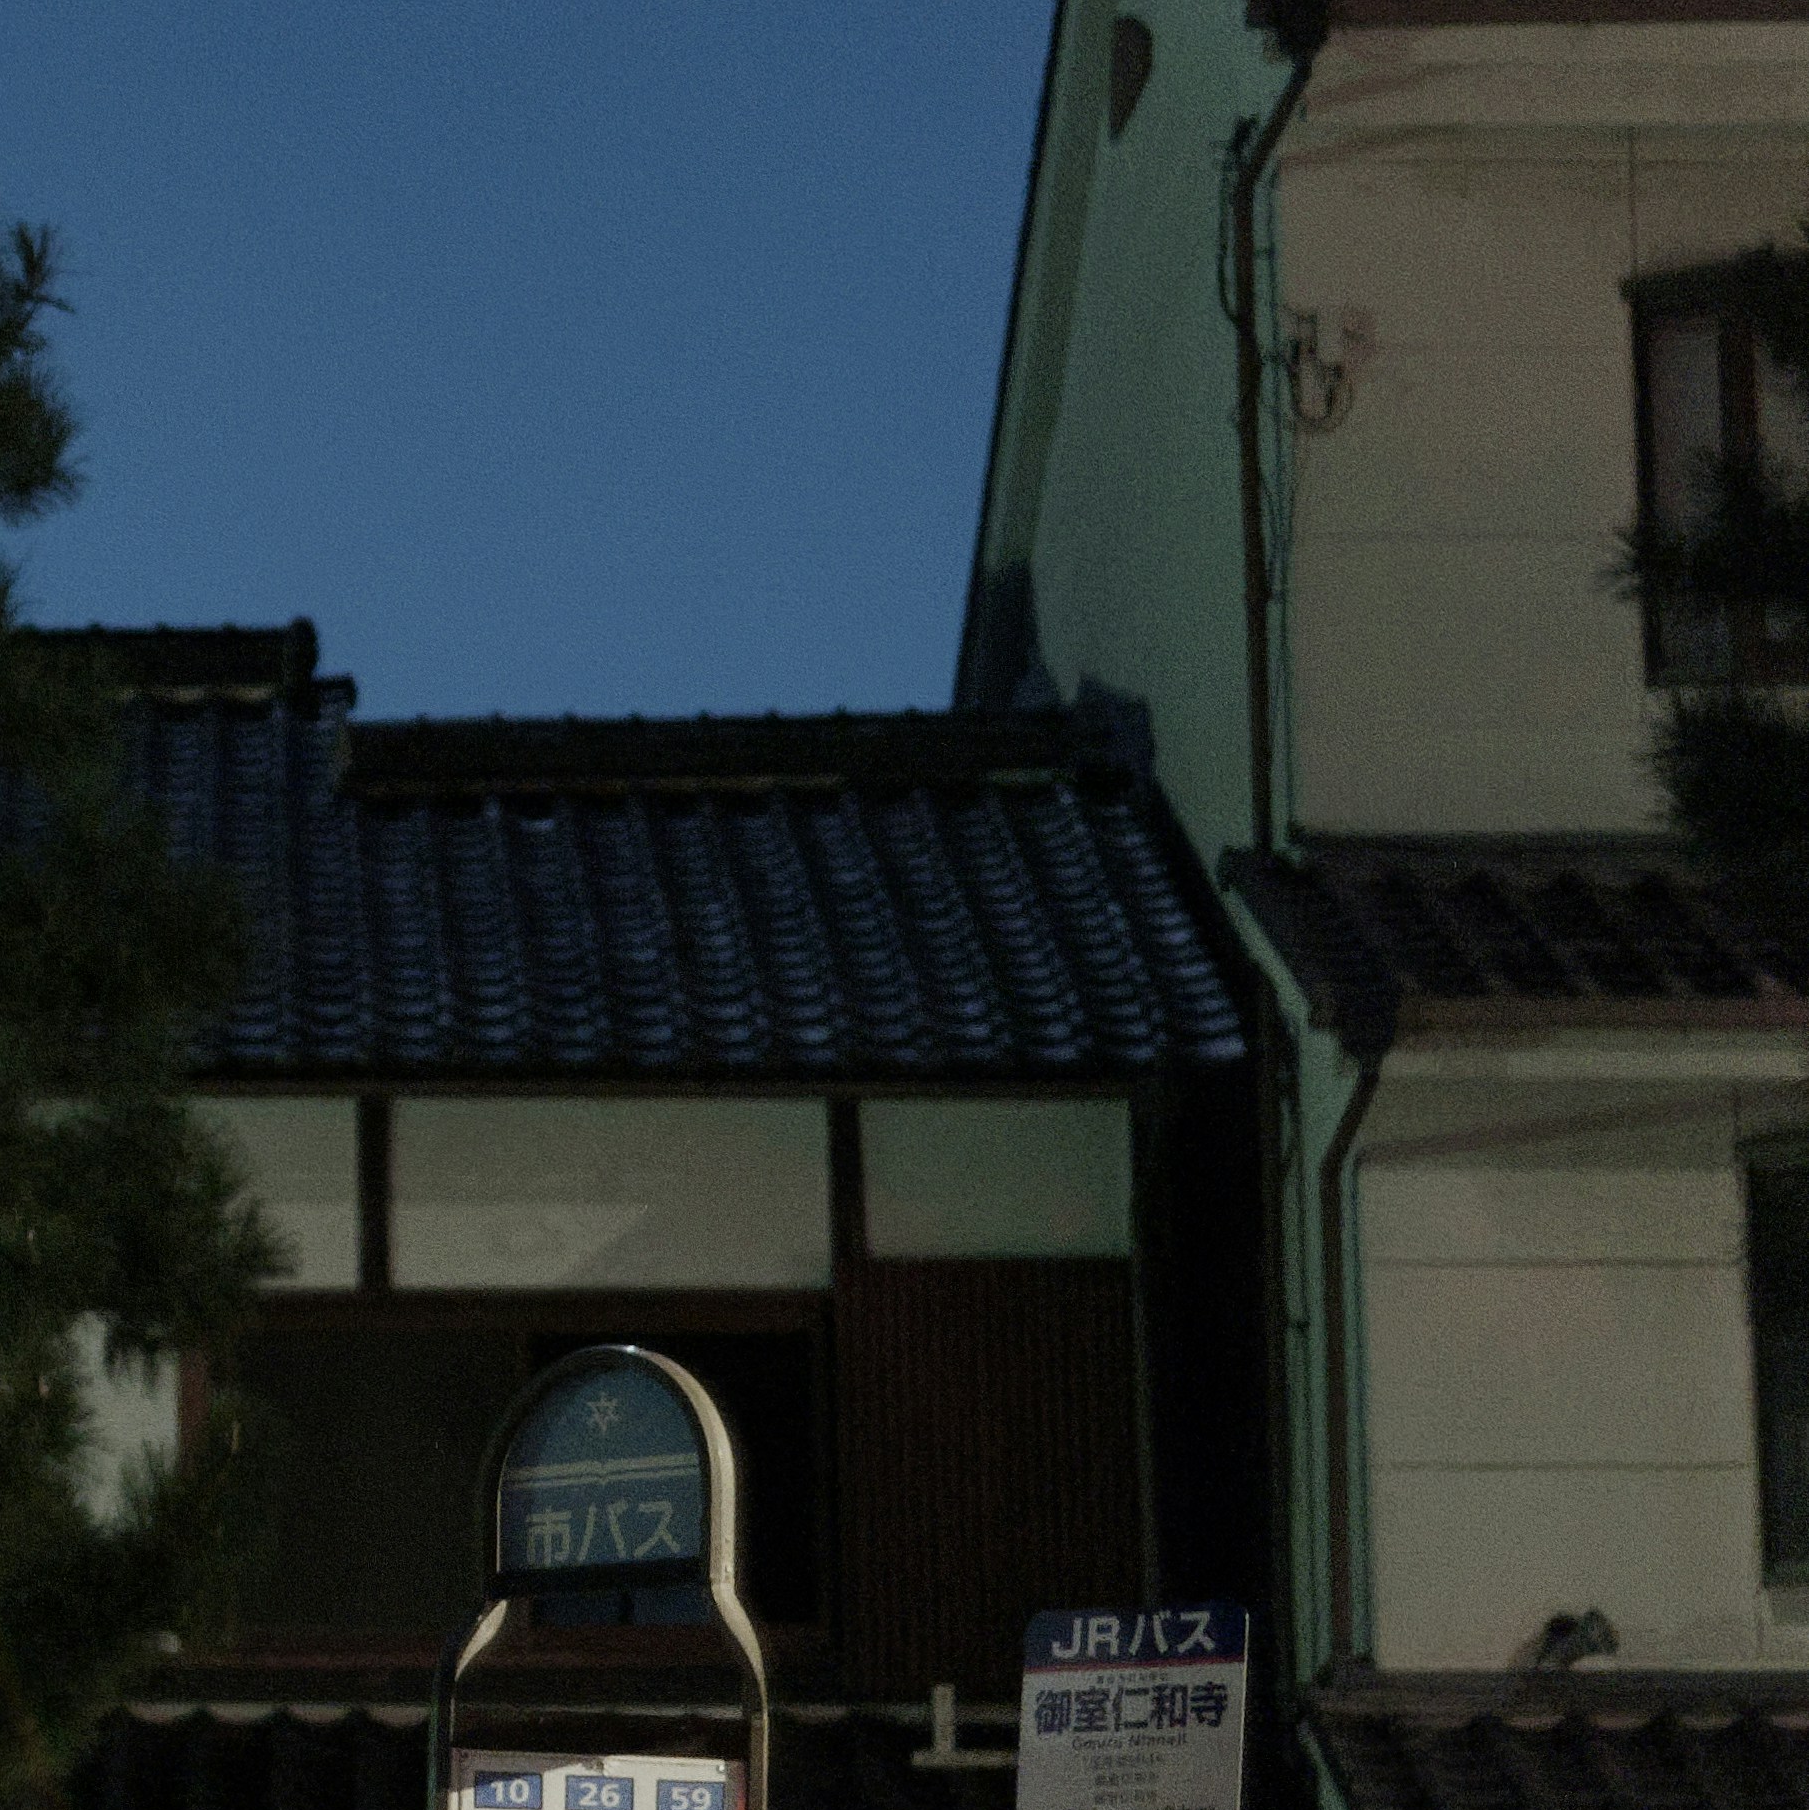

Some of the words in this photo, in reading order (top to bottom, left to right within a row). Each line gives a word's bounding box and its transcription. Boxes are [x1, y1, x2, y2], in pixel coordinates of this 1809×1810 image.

[525, 1498, 681, 1567] 市バス
[1051, 1610, 1216, 1659] JRバス
[1034, 1681, 1228, 1737] 御室仁和寺
[489, 1779, 530, 1805] 10
[579, 1782, 620, 1809] 26
